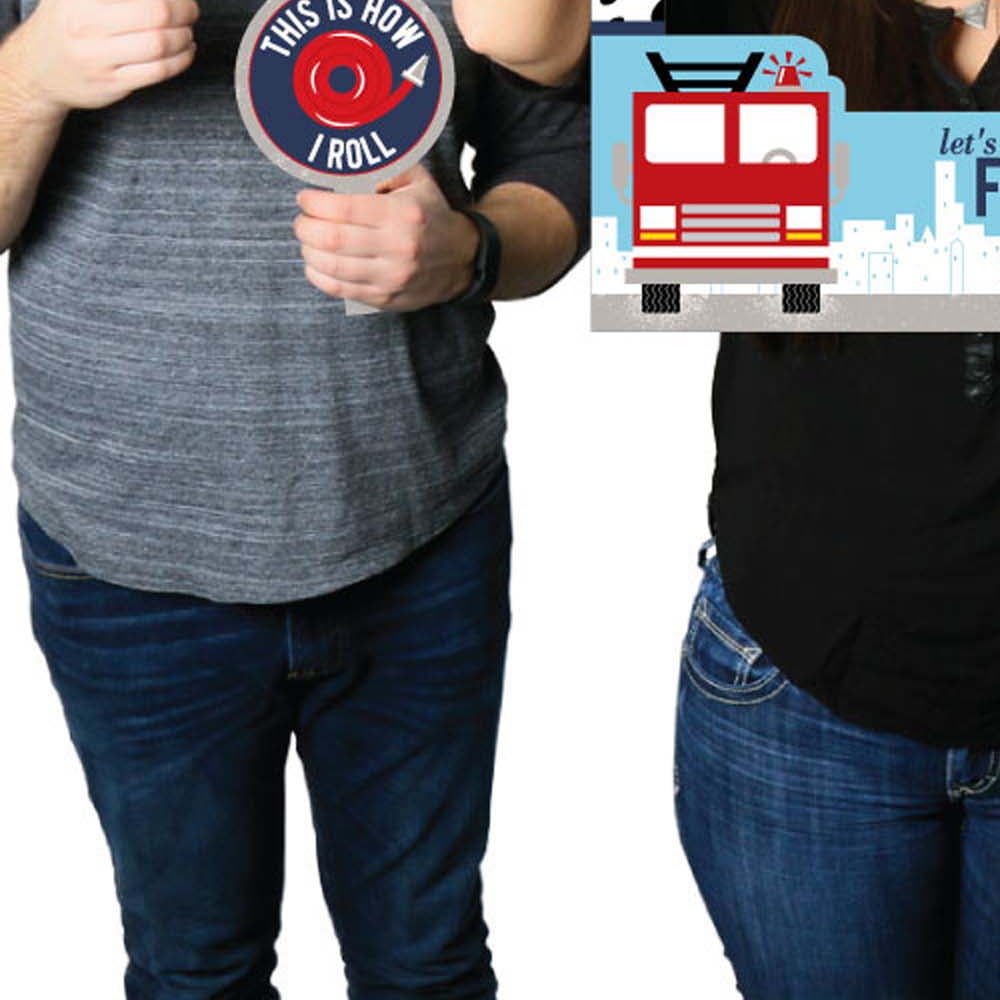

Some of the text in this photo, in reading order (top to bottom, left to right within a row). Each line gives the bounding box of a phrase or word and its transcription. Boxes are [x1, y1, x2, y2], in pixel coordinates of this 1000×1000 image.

[307, 131, 397, 170] I ROLL
[939, 127, 997, 156] let's
